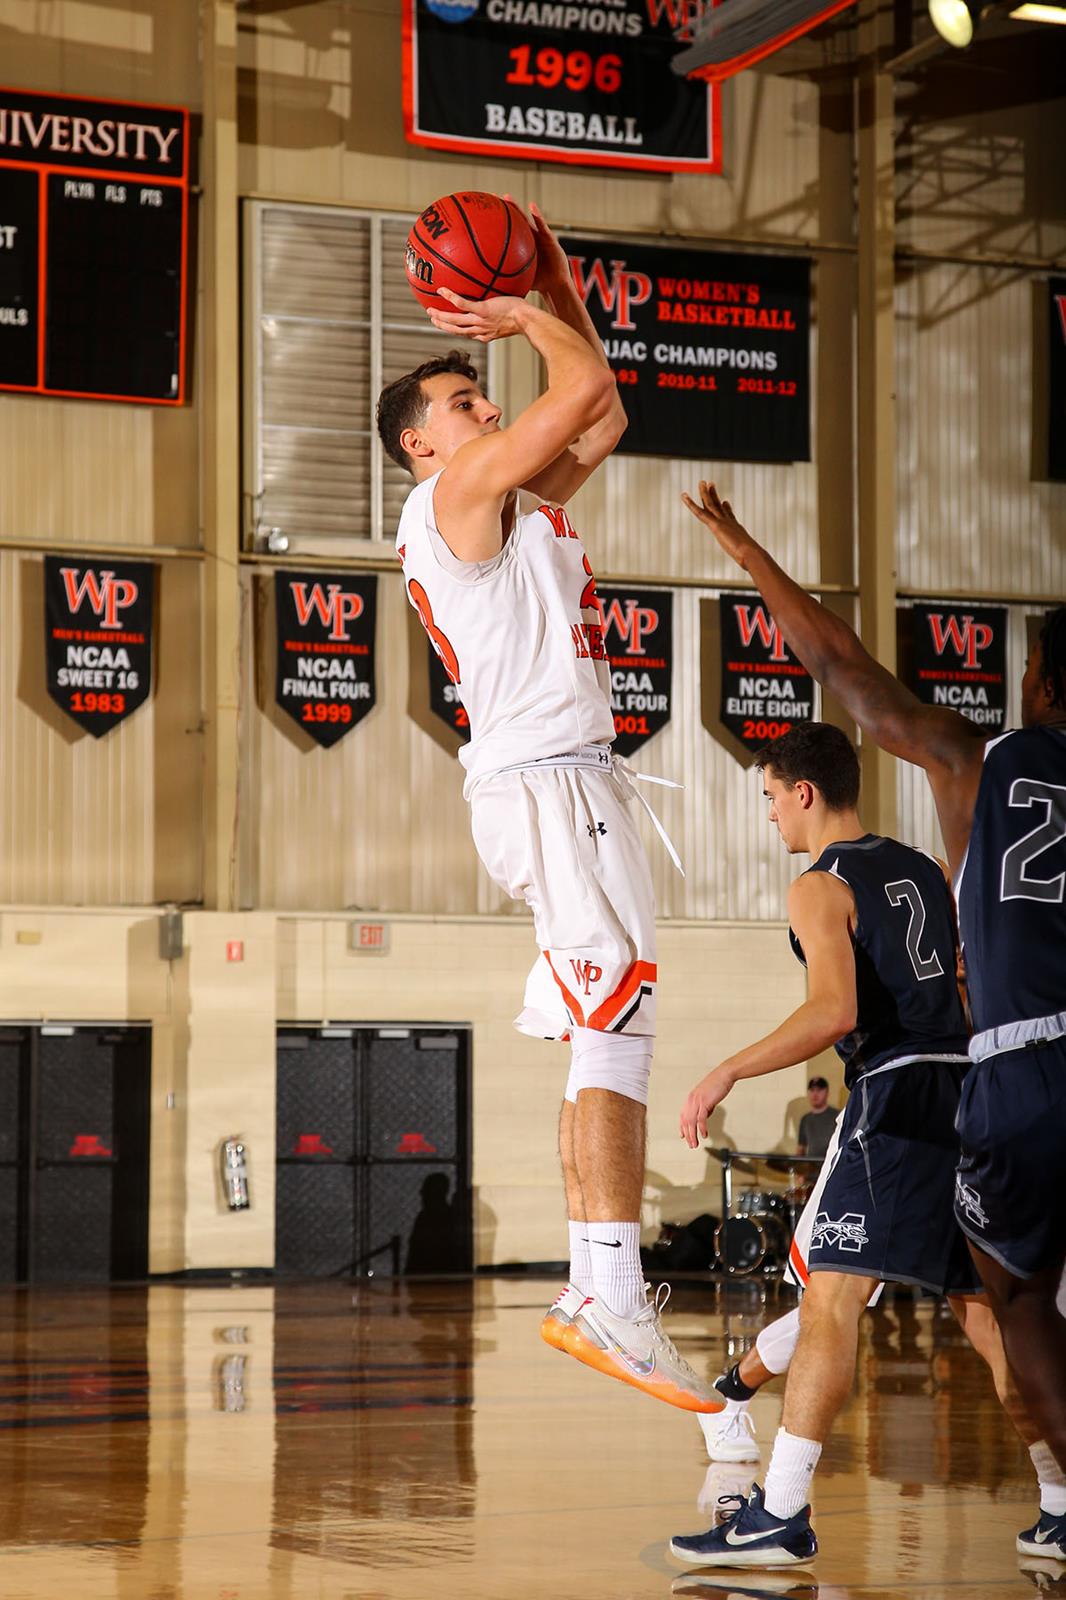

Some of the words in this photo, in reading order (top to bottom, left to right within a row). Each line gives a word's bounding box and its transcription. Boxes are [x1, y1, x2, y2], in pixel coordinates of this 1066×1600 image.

[486, 0, 643, 37] CHAMPIONS
[505, 44, 623, 93] 1996
[484, 103, 643, 145] BASEBALL
[567, 254, 653, 331] WP
[657, 277, 760, 305] WOMEN'S
[657, 300, 796, 331] BASKETBALL
[654, 343, 778, 371] CHAMPIONS
[657, 372, 718, 391] 2010-11
[737, 377, 797, 397] 2011-12
[60, 567, 138, 629] WP
[289, 582, 364, 641] WP
[599, 597, 659, 656] WP
[927, 613, 994, 669] WP
[67, 645, 131, 670] NCAA
[297, 657, 357, 680] NCAA
[57, 667, 115, 689] SWEET
[117, 671, 139, 690] 16
[282, 678, 328, 698] FINAL
[329, 681, 371, 699] FOUR
[611, 671, 654, 692] CAA
[739, 677, 796, 700] NCAA
[70, 692, 126, 714] 1983
[626, 694, 668, 712] FOUR
[726, 697, 765, 717] ELITE
[766, 700, 811, 719] EIGHT
[932, 685, 989, 706] NCAA
[302, 702, 353, 723] 1999
[1000, 778, 1066, 903] 2
[885, 879, 945, 981] 2
[569, 959, 603, 995] WP
